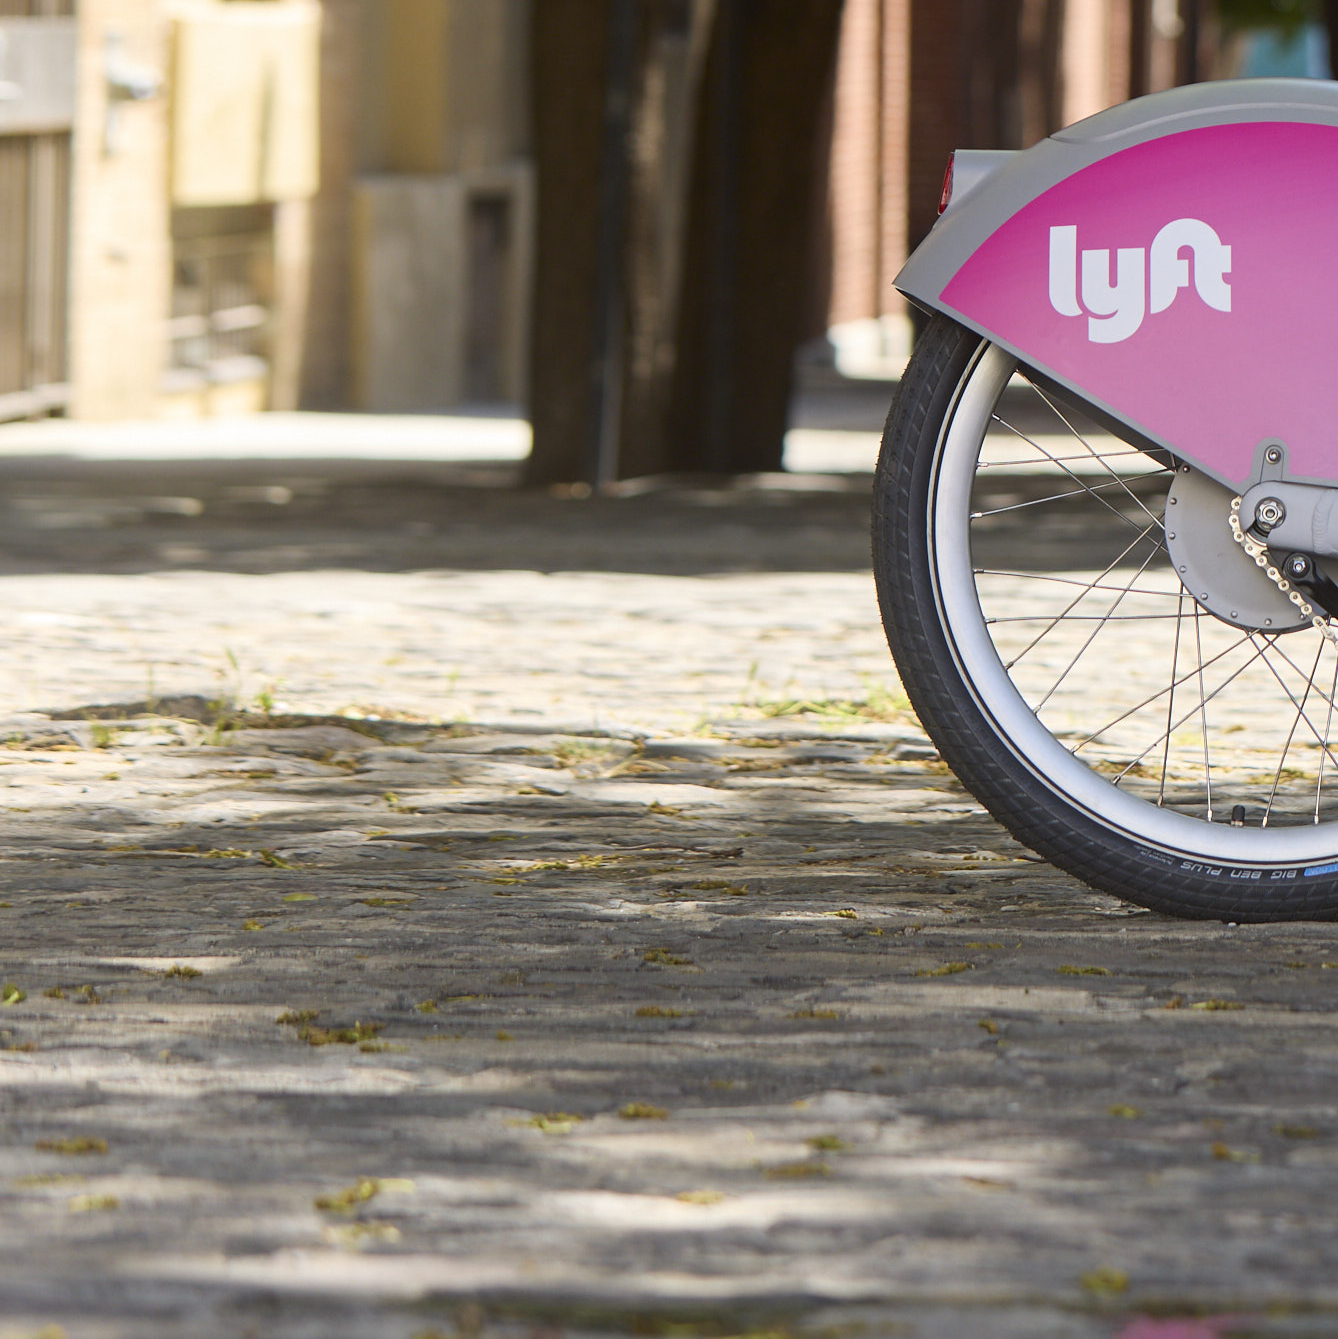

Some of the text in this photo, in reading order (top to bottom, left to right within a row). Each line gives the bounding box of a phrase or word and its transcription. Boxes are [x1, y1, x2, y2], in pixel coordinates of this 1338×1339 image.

[1049, 218, 1232, 344] lyft
[1180, 861, 1222, 876] PLUS
[1270, 869, 1297, 880] BIG
